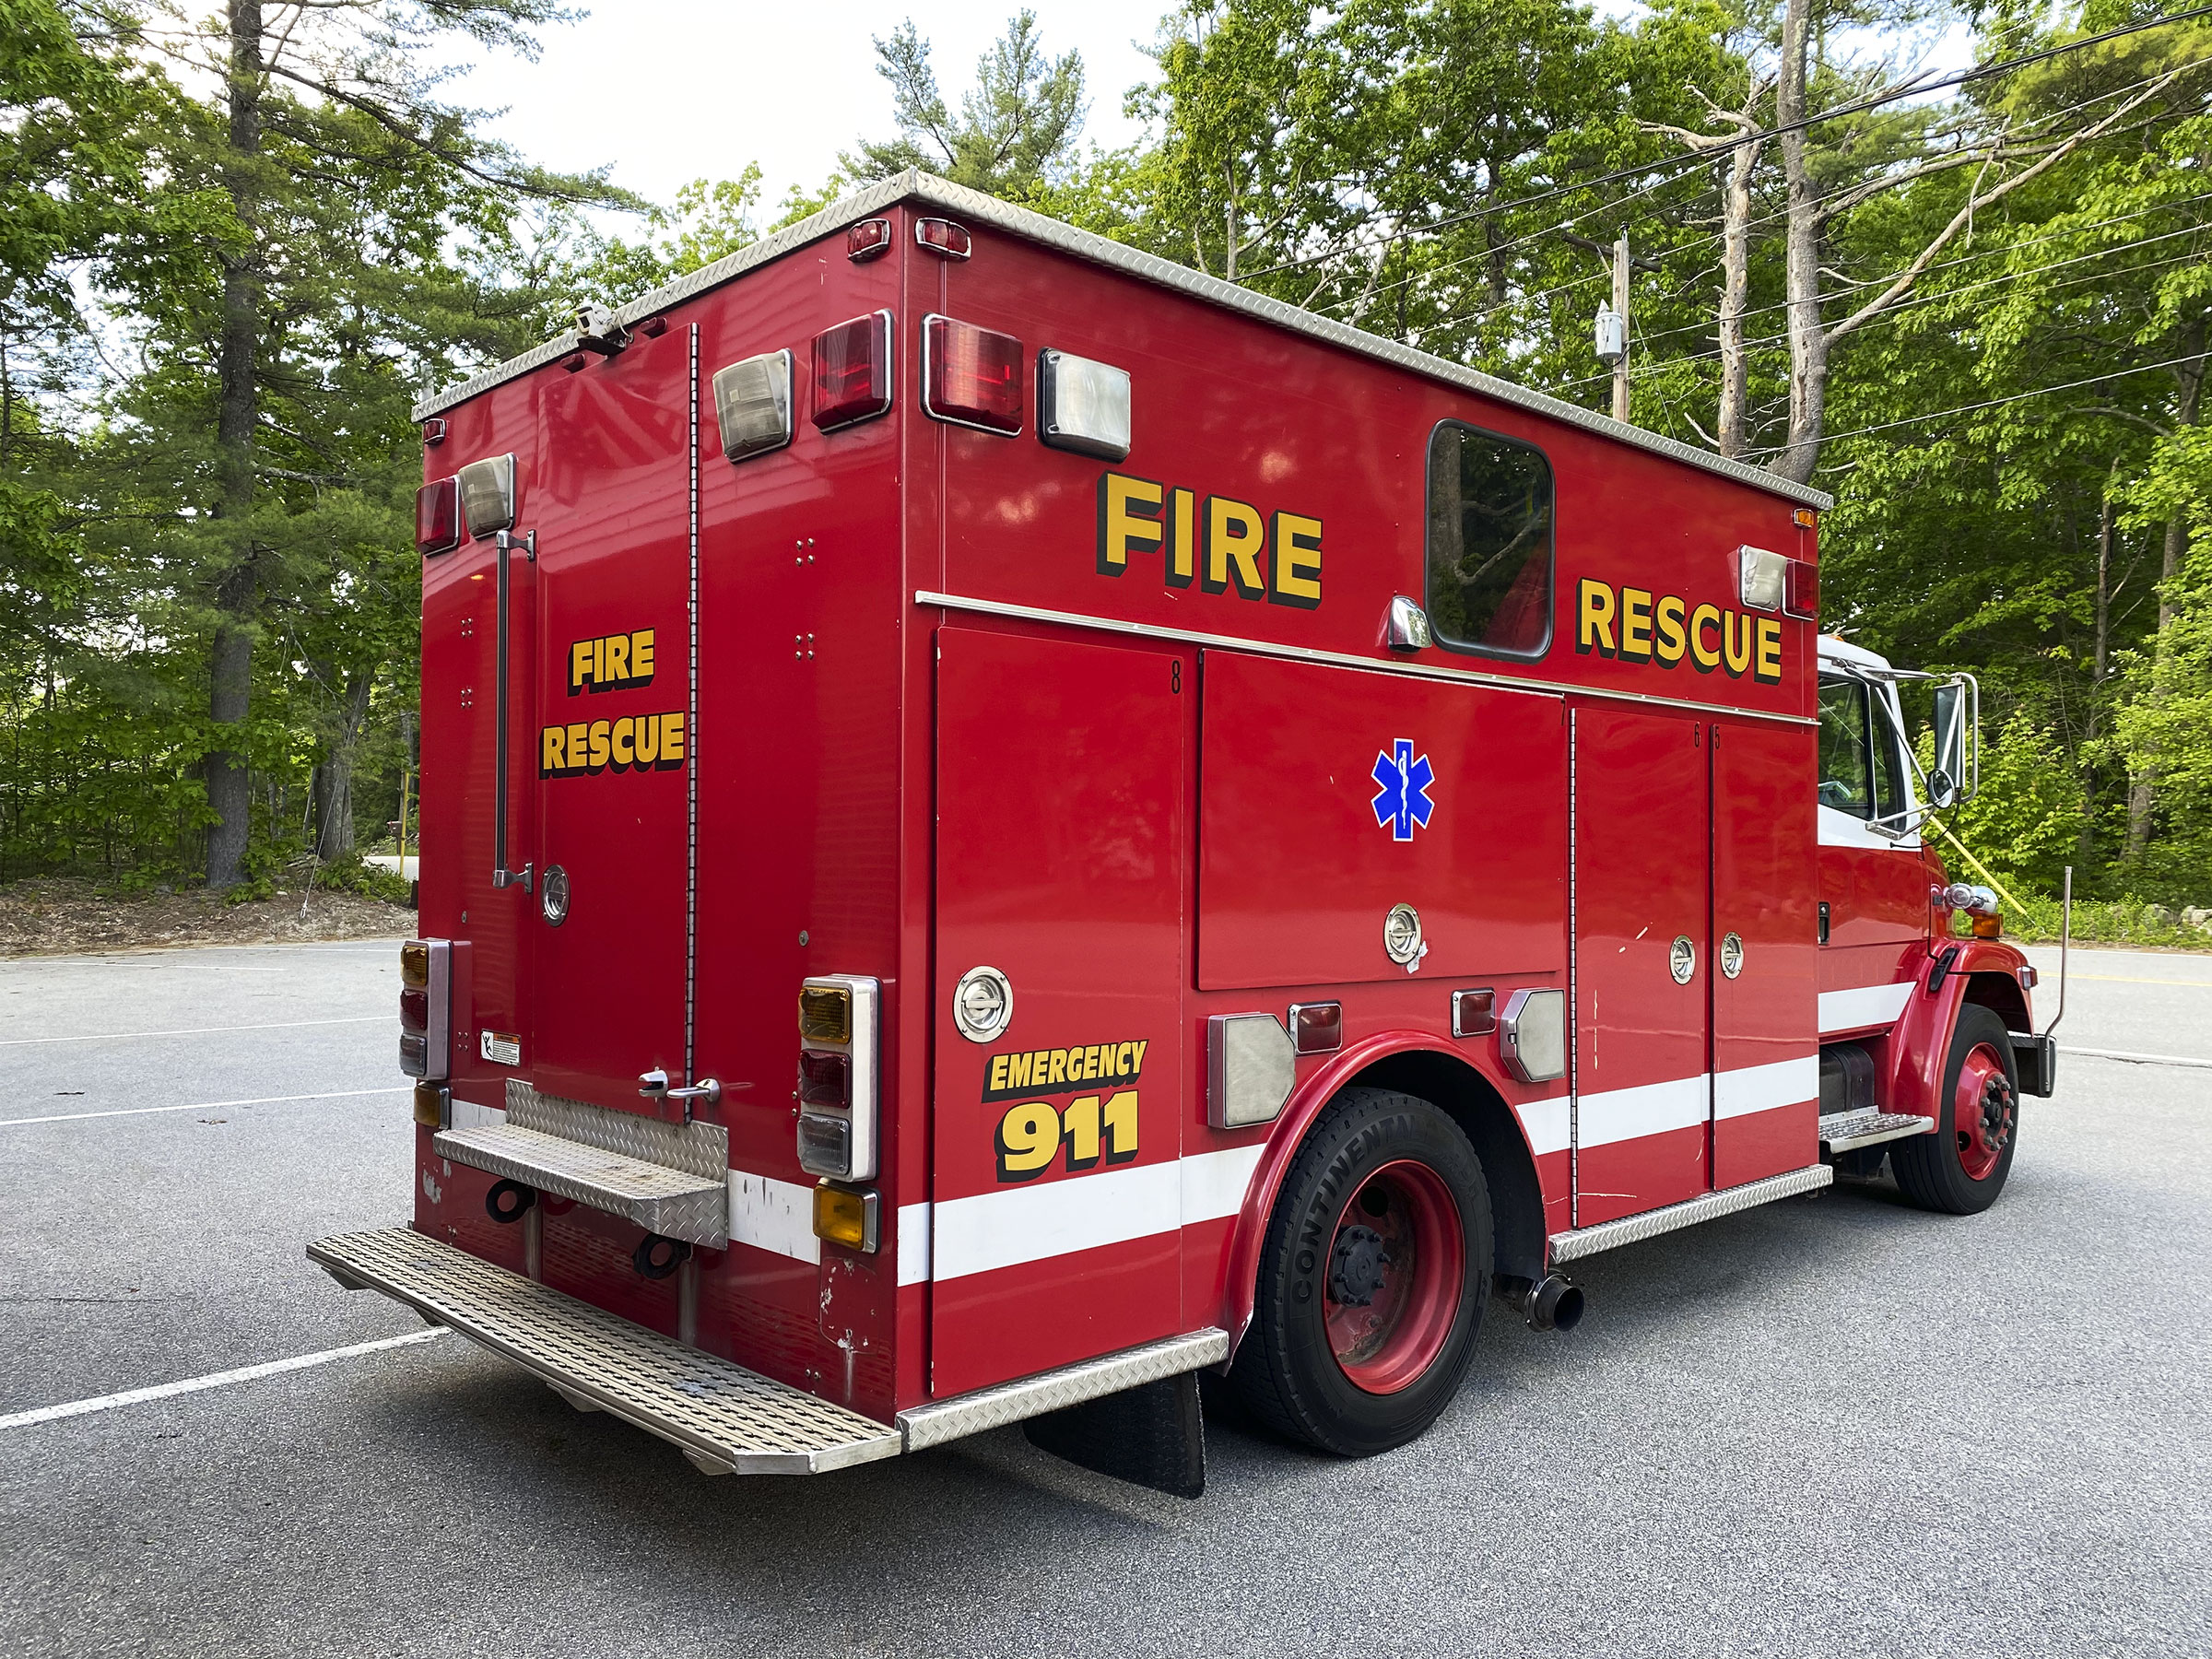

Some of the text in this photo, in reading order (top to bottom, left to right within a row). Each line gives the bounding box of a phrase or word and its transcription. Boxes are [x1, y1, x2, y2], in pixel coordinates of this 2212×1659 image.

[1096, 470, 1324, 610] FIRE
[568, 628, 655, 698] FIRE
[1576, 578, 1782, 685] RESCUE
[1171, 660, 1181, 694] 8
[539, 712, 685, 781] RESCUE
[1694, 723, 1700, 747] 6
[1714, 725, 1721, 750] 5
[982, 1040, 1149, 1103] EMERGENCY
[994, 1089, 1139, 1183] 911
[1294, 1113, 1428, 1305] CONTINENTAL
